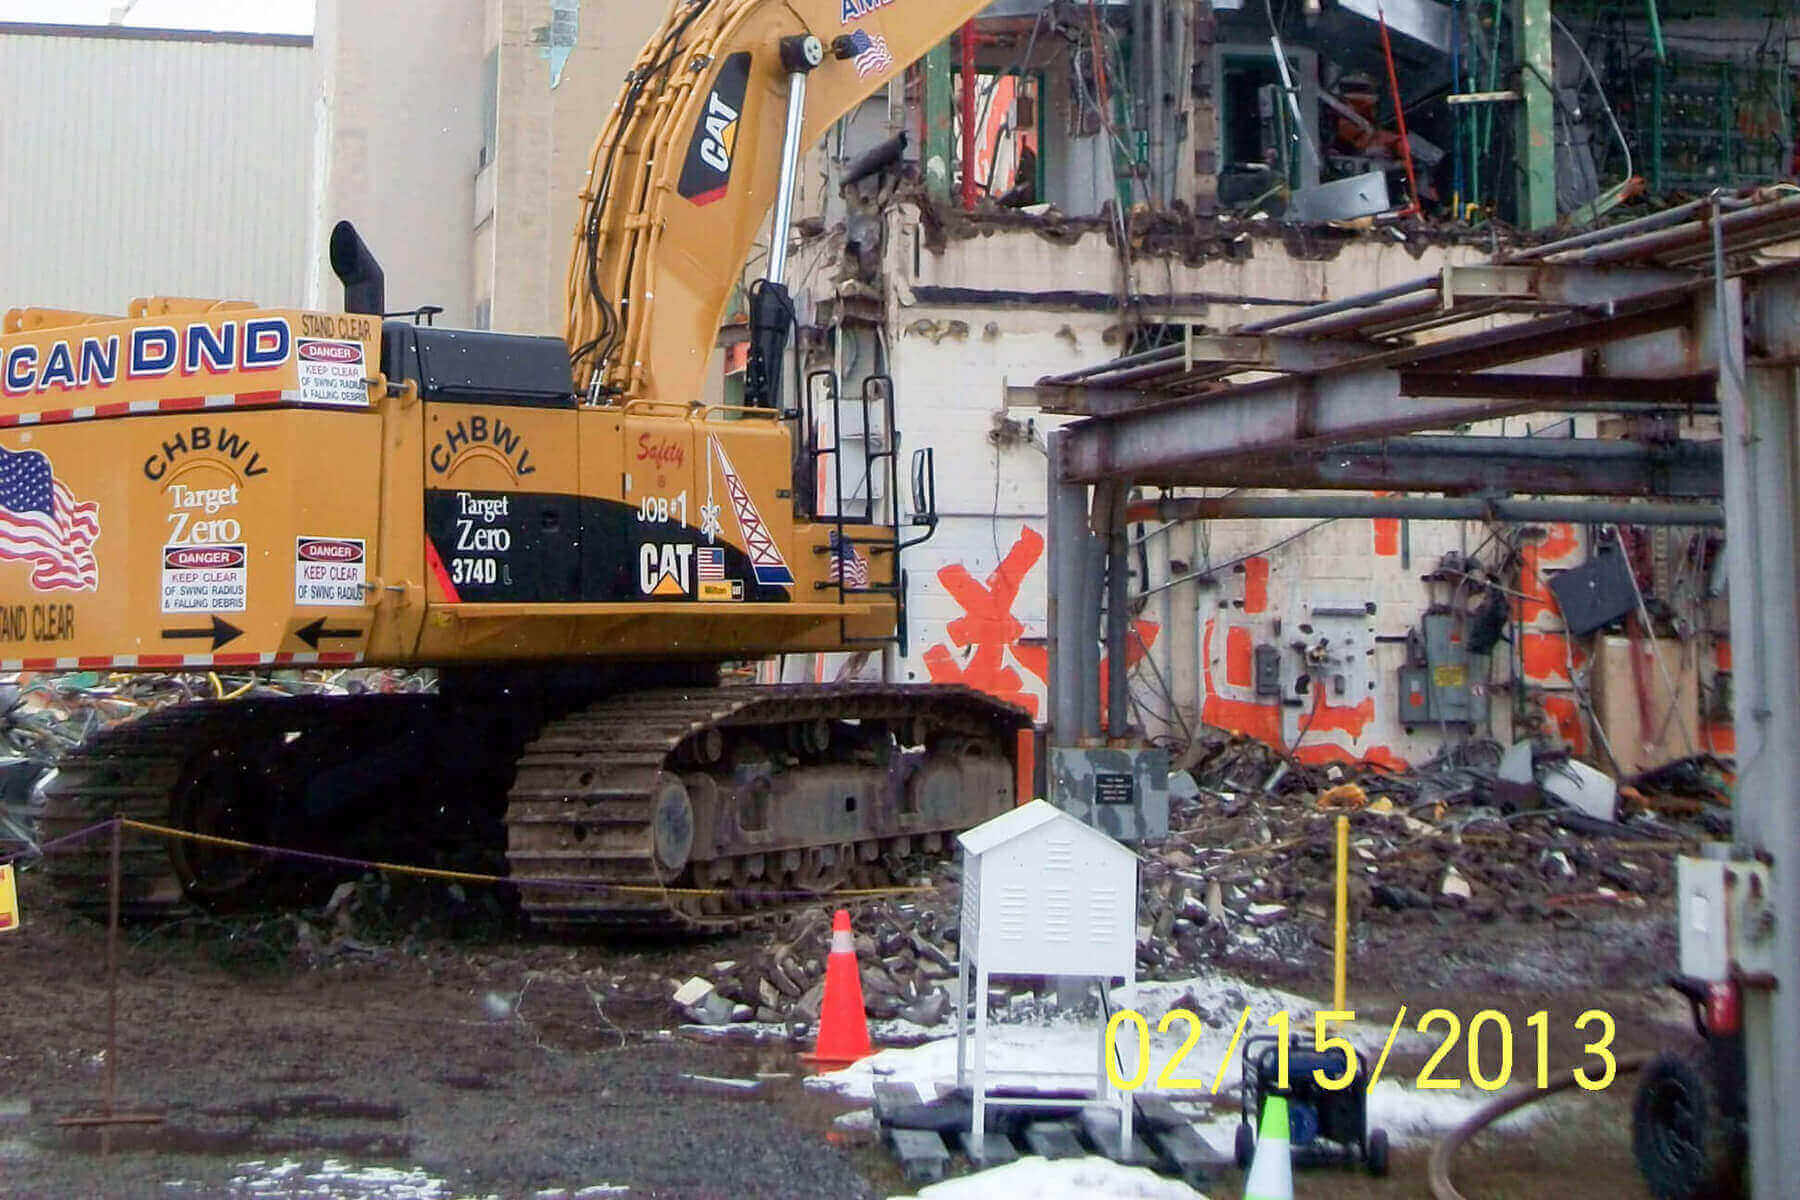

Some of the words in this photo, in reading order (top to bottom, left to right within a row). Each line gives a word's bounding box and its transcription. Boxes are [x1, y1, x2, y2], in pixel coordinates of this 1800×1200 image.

[701, 90, 739, 172] CAT
[302, 313, 334, 338] STAND
[338, 317, 371, 341] CLEAR
[0, 334, 120, 398] CAN
[127, 318, 292, 380] DND
[309, 346, 352, 359] DANGER
[301, 377, 311, 387] OF
[304, 365, 328, 376] KEEP
[331, 367, 359, 378] CLEAR
[144, 426, 268, 481] CHBWV
[431, 415, 536, 474] CHBWV
[636, 432, 685, 470] Safety
[168, 483, 239, 514] Target
[456, 491, 509, 523] Target
[637, 495, 668, 522] JOB
[167, 511, 241, 545] Zero
[456, 518, 511, 552] Zero
[178, 551, 230, 564] DANGER
[309, 545, 352, 558] DANGER
[172, 573, 199, 583] KEEP
[202, 572, 237, 583] CLEAR
[304, 565, 326, 579] KEEP
[329, 566, 358, 581] CLEAR
[452, 558, 497, 584] 374D
[640, 543, 693, 594] CAT
[165, 586, 176, 596] OF
[180, 586, 208, 596] SWING
[211, 585, 244, 595] RADIUS
[174, 598, 208, 608] FALLING
[211, 598, 244, 608] DEBRIS
[298, 584, 308, 599] OF
[311, 585, 335, 600] SWING
[337, 585, 363, 601] RADIUS
[32, 603, 75, 642] CLEAR
